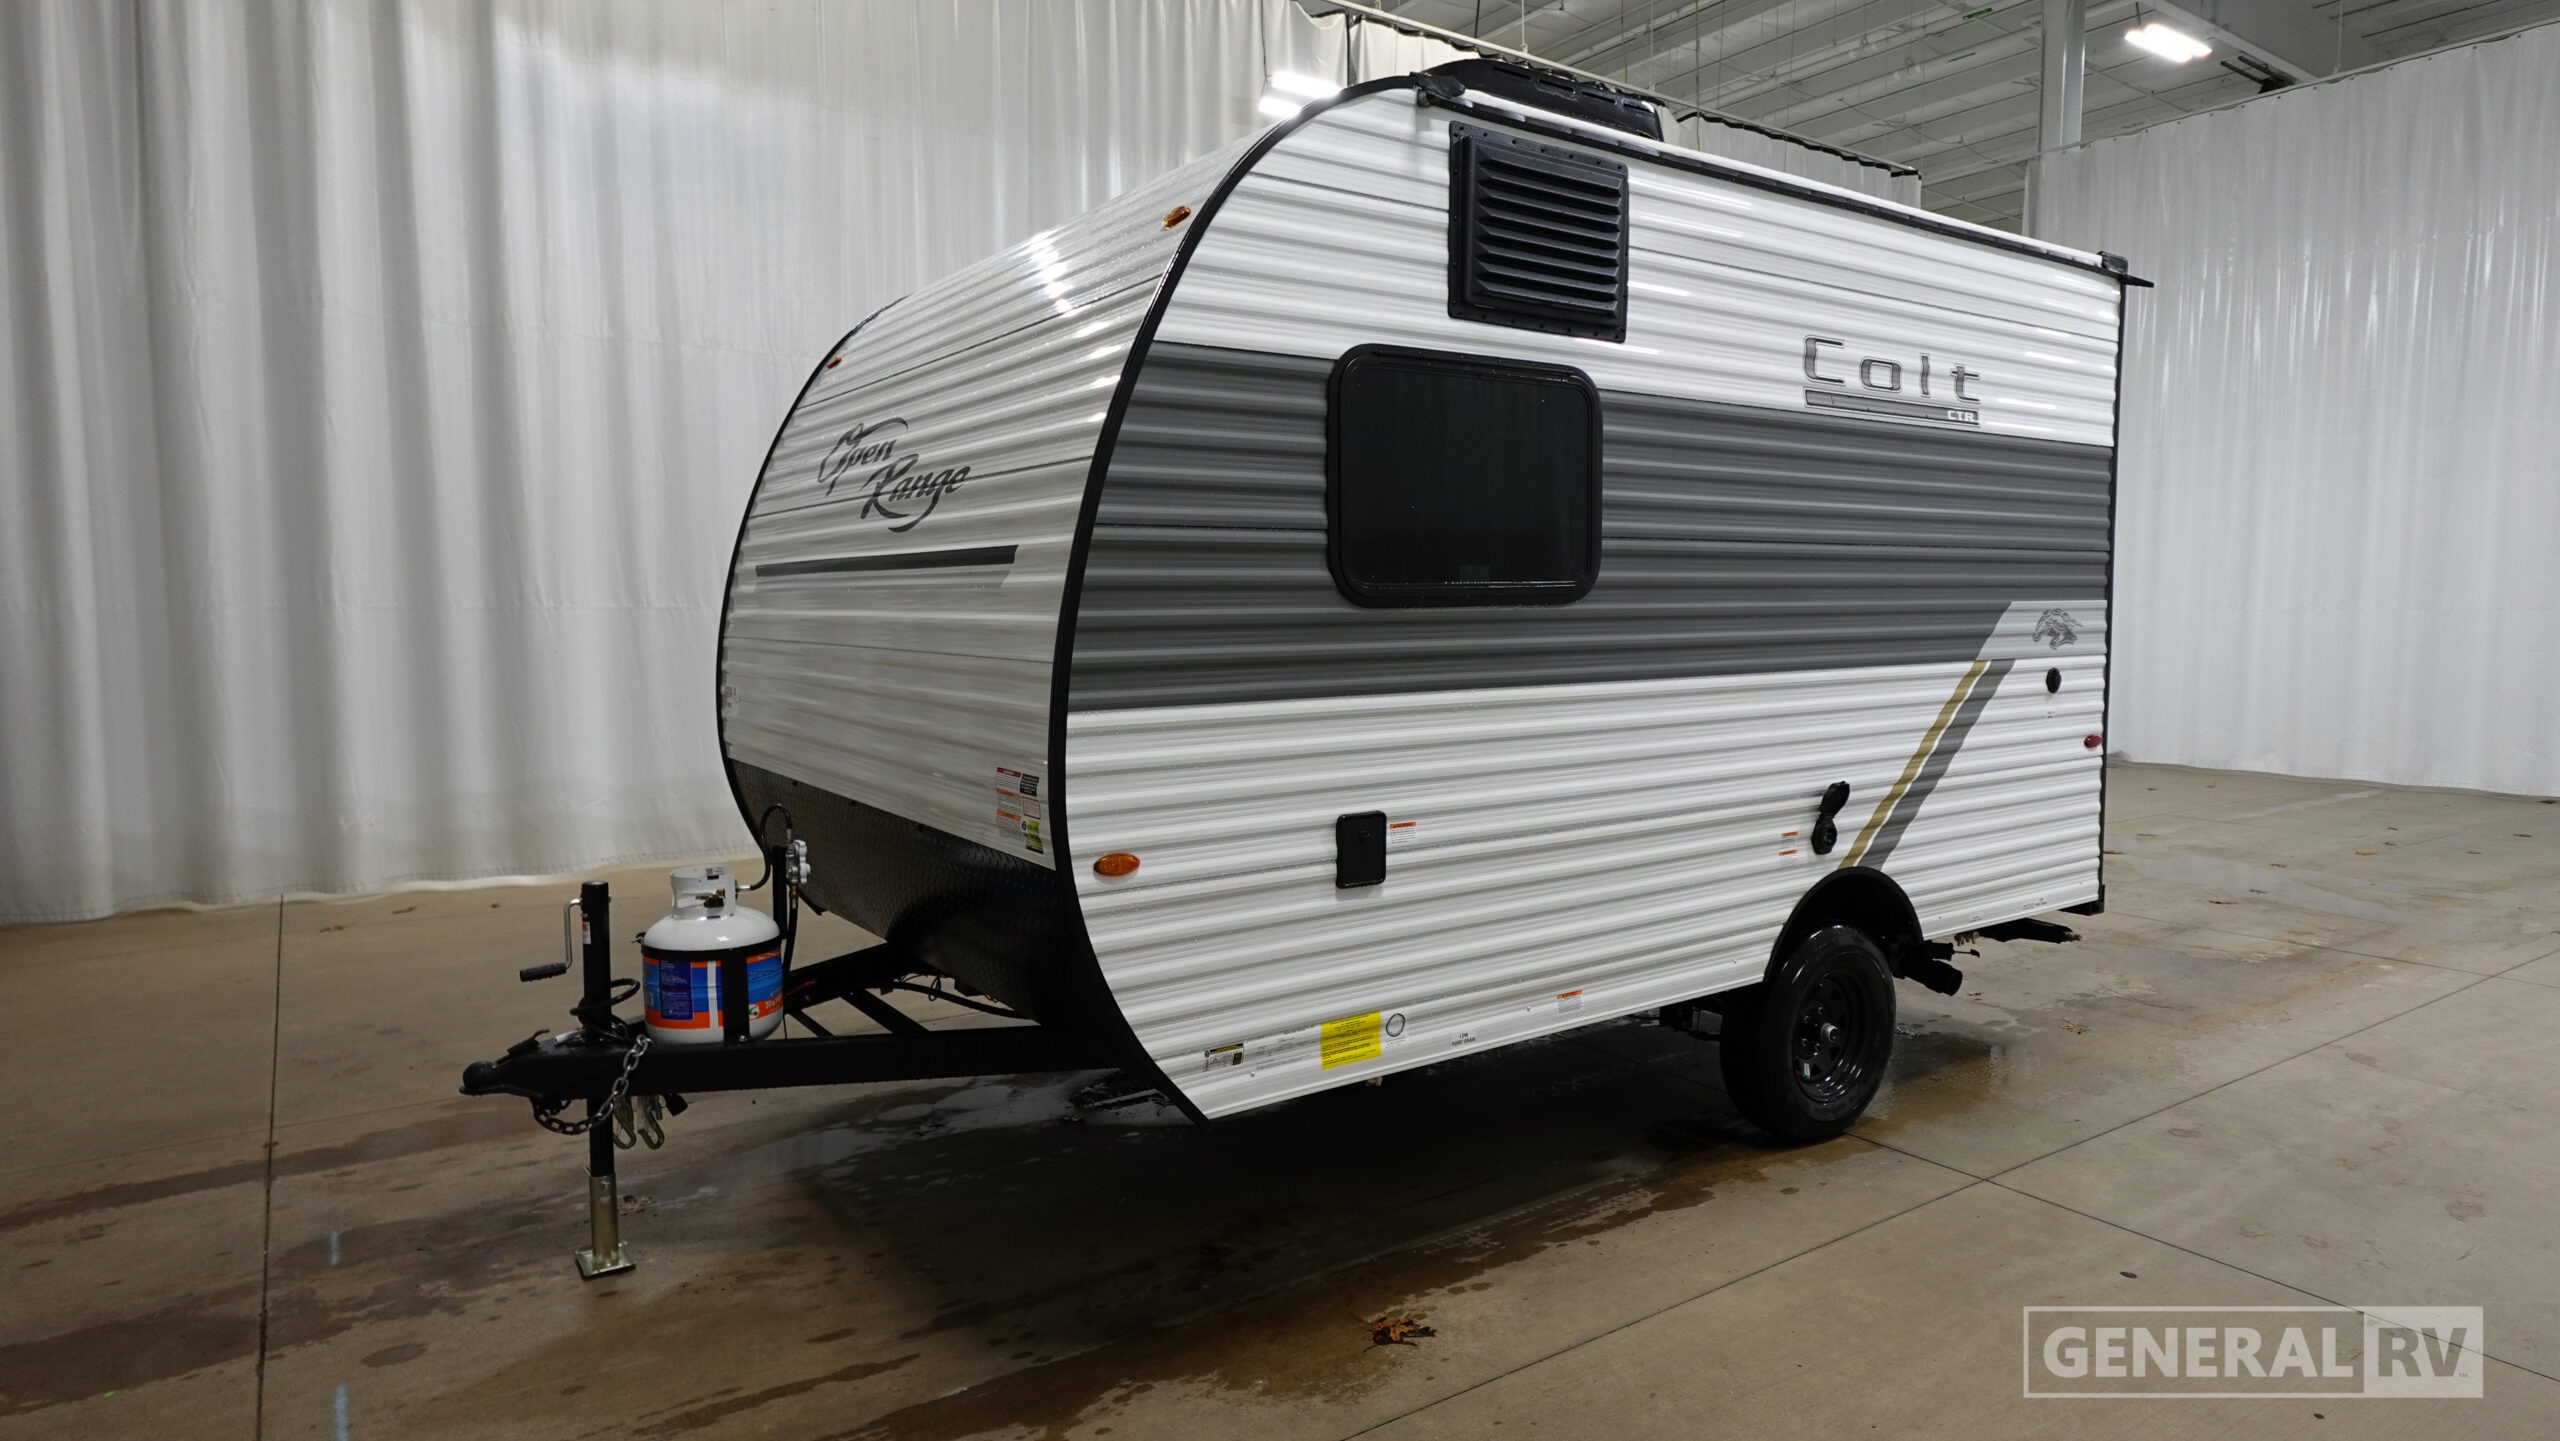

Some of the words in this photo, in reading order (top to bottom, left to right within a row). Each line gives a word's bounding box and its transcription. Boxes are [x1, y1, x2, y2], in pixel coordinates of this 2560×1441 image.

[1804, 335, 1980, 403] Colt
[1947, 410, 1975, 422] CTR
[817, 416, 909, 497] Open
[858, 453, 971, 533] Range
